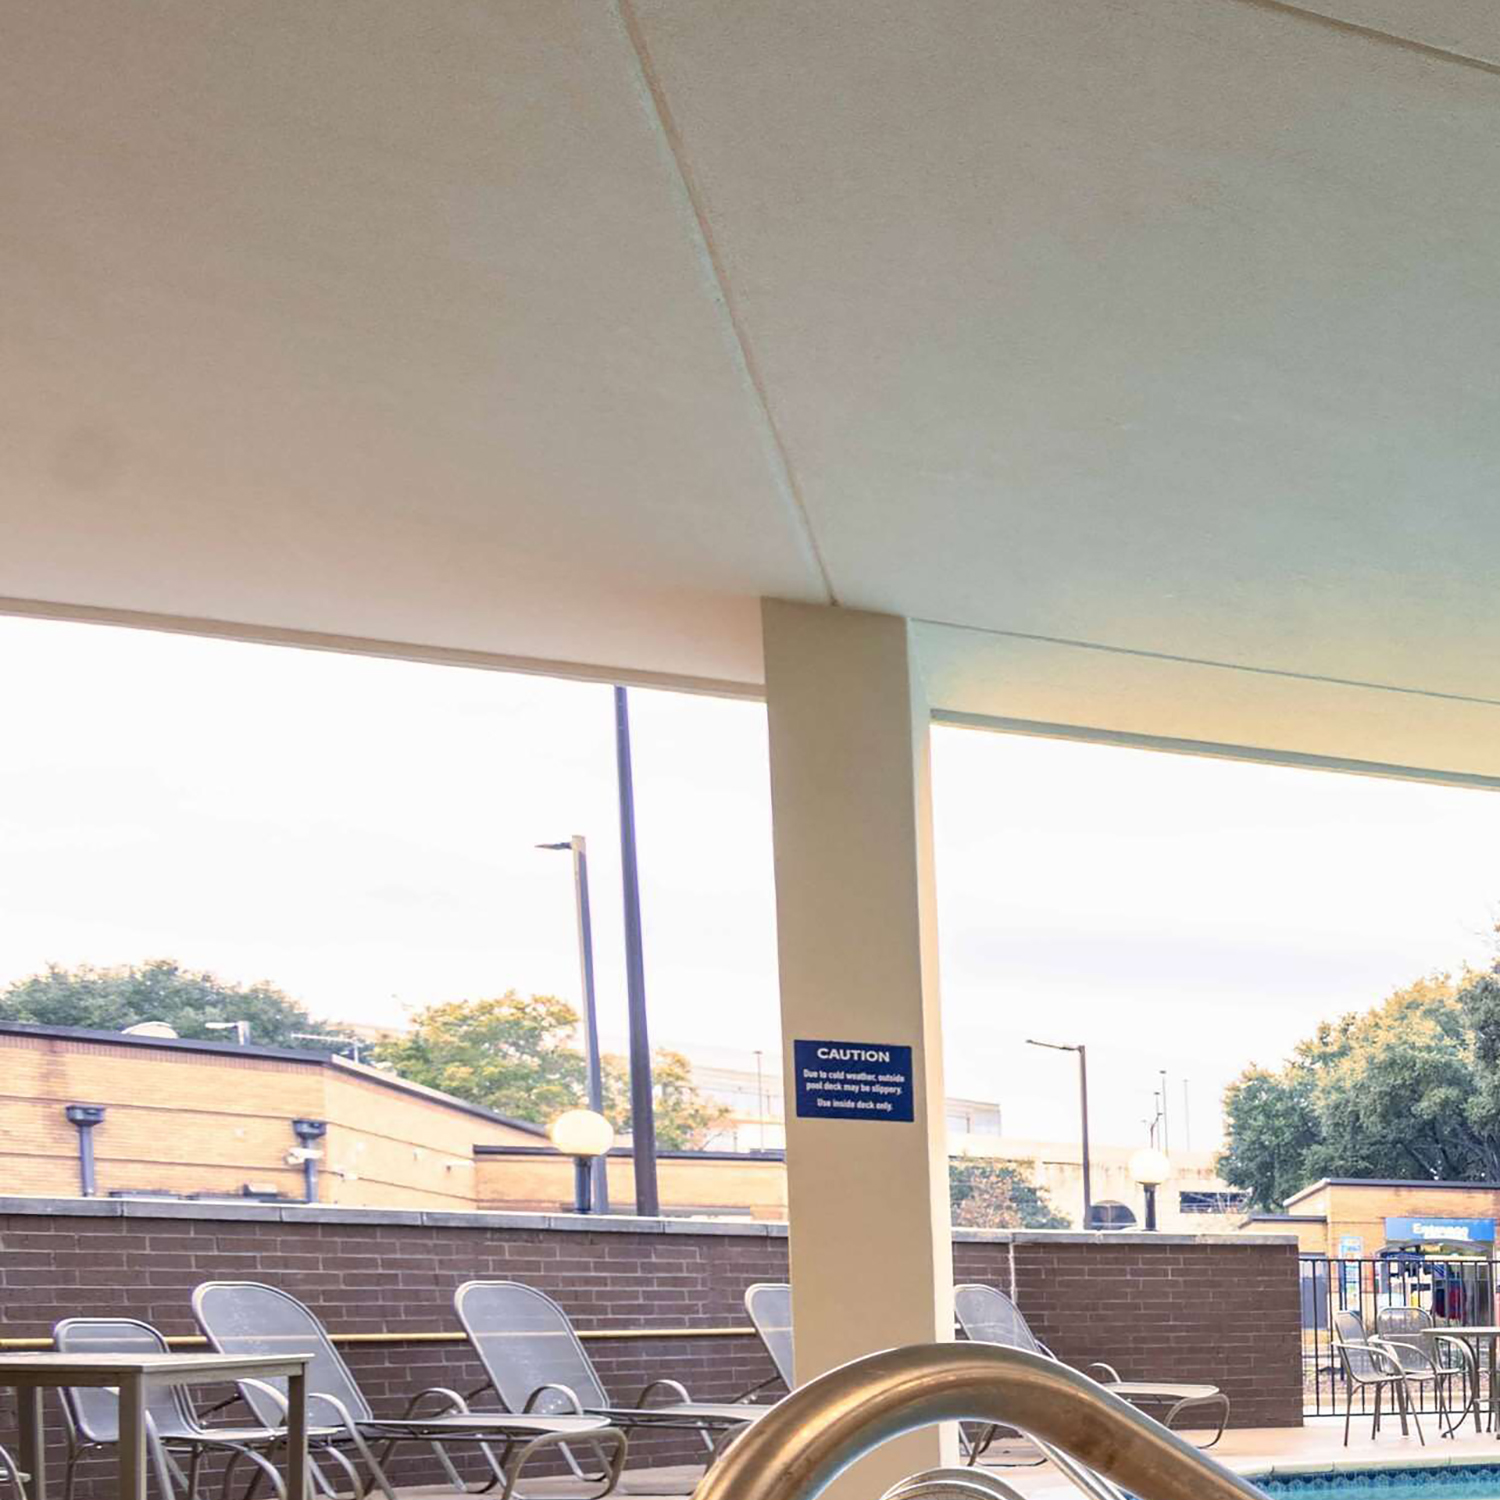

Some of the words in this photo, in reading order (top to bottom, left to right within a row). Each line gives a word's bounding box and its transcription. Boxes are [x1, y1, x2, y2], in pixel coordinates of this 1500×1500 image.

[817, 1047, 890, 1063] CAUTION
[803, 1069, 818, 1078] Due
[819, 1070, 826, 1078] to
[828, 1070, 844, 1079] cold
[878, 1073, 905, 1083] outside
[806, 1081, 822, 1091] pool
[824, 1082, 842, 1091] deck
[843, 1084, 859, 1094] may
[861, 1083, 870, 1092] be
[817, 1098, 831, 1107] Use
[832, 1099, 855, 1108] inside
[857, 1100, 874, 1109] deck
